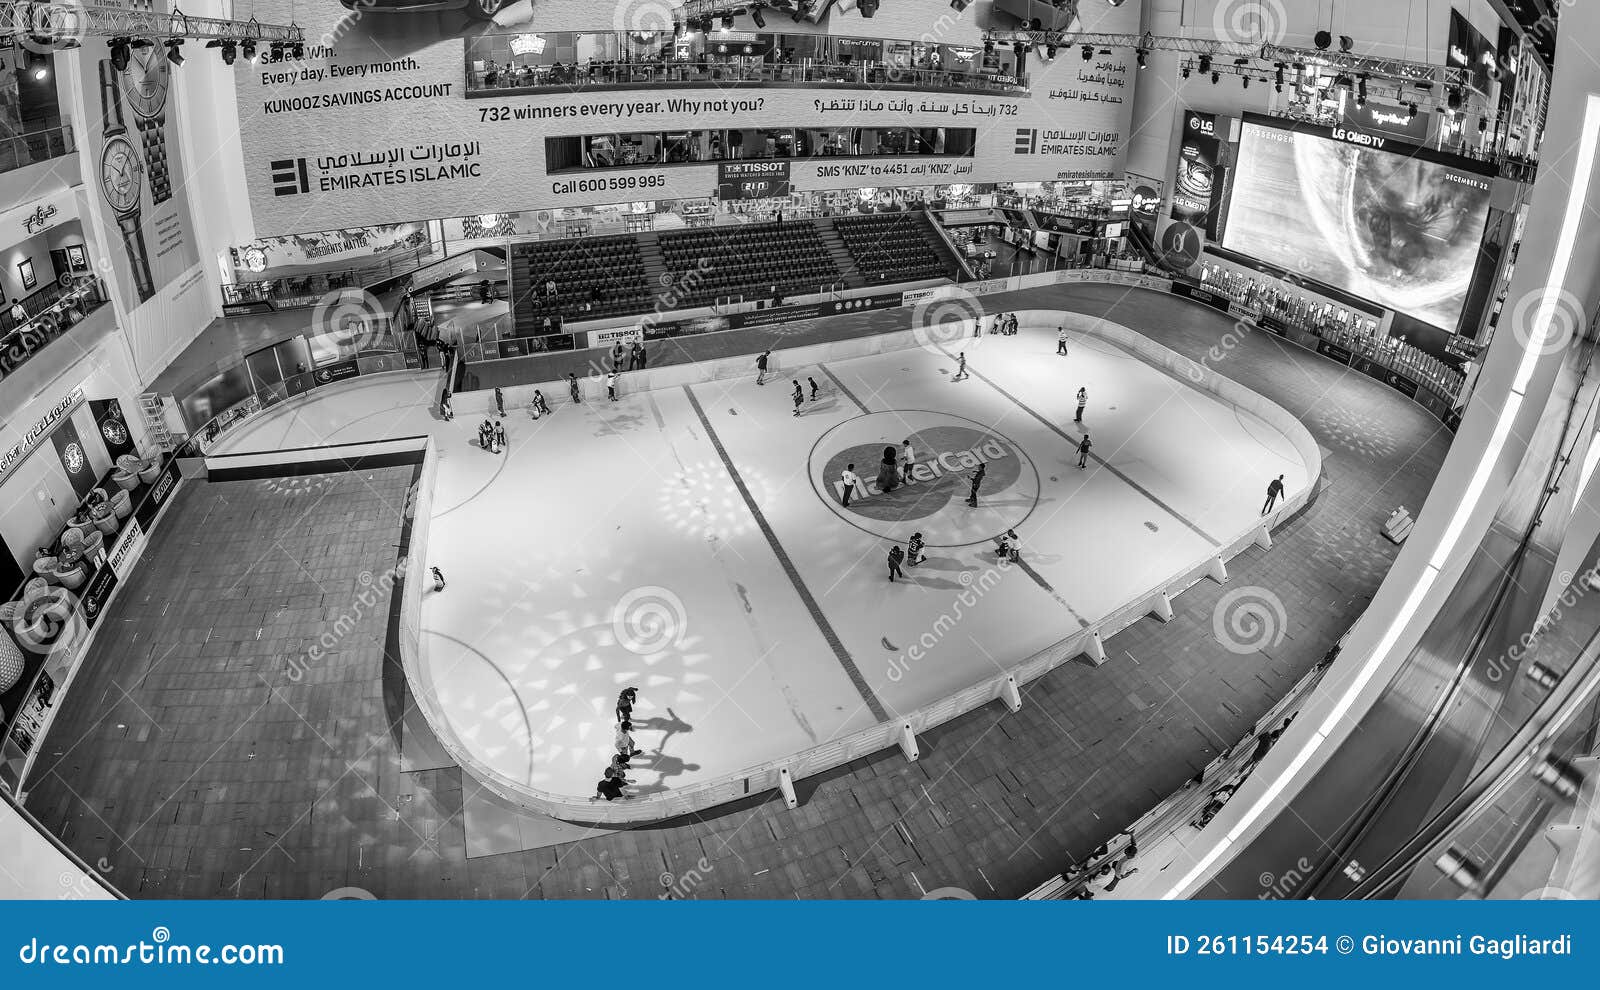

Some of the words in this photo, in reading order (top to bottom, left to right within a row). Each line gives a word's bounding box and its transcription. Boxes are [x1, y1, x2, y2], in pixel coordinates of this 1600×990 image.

[261, 51, 292, 64] Sae
[307, 45, 337, 59] Win.
[262, 72, 297, 85] Every
[301, 67, 328, 81] day.
[330, 64, 367, 77] Every
[370, 57, 420, 73] month.
[264, 96, 320, 114] KUNOOZ
[322, 89, 381, 107] SAVINGS
[384, 83, 452, 101] ACCOUNT
[859, 98, 884, 112] ماذا
[888, 98, 913, 114] وأنت
[479, 106, 511, 122] 732
[513, 105, 577, 119] winners
[580, 103, 624, 117] every
[626, 102, 665, 117] year.
[667, 98, 701, 115] Why
[703, 99, 728, 112] not
[731, 97, 765, 114] you?
[952, 103, 968, 116] كل
[999, 104, 1018, 116] 732
[1200, 119, 1213, 131] LG
[1247, 127, 1295, 144] PASSENGER
[1332, 127, 1345, 140] LG
[1346, 131, 1372, 145] OLED
[1372, 136, 1385, 148] TV
[410, 141, 480, 163] الإمارات
[1041, 144, 1085, 155] EMIRATES
[1085, 145, 1117, 156] ISLAMIC
[317, 148, 404, 175] الإسلامي
[742, 162, 785, 172] TISSOT
[320, 169, 406, 191] EMIRATES
[410, 163, 481, 182] ISLAMIC
[816, 166, 840, 178] SMS
[870, 165, 881, 175] to
[882, 163, 908, 175] 4451
[552, 180, 577, 194] Call
[579, 178, 607, 192] 600
[609, 176, 636, 190] 599
[639, 174, 665, 188] 995
[1445, 173, 1477, 187] DECEMBER
[1480, 182, 1488, 190] 22
[610, 328, 640, 338] TISSOT
[119, 523, 140, 555] TISSOT
